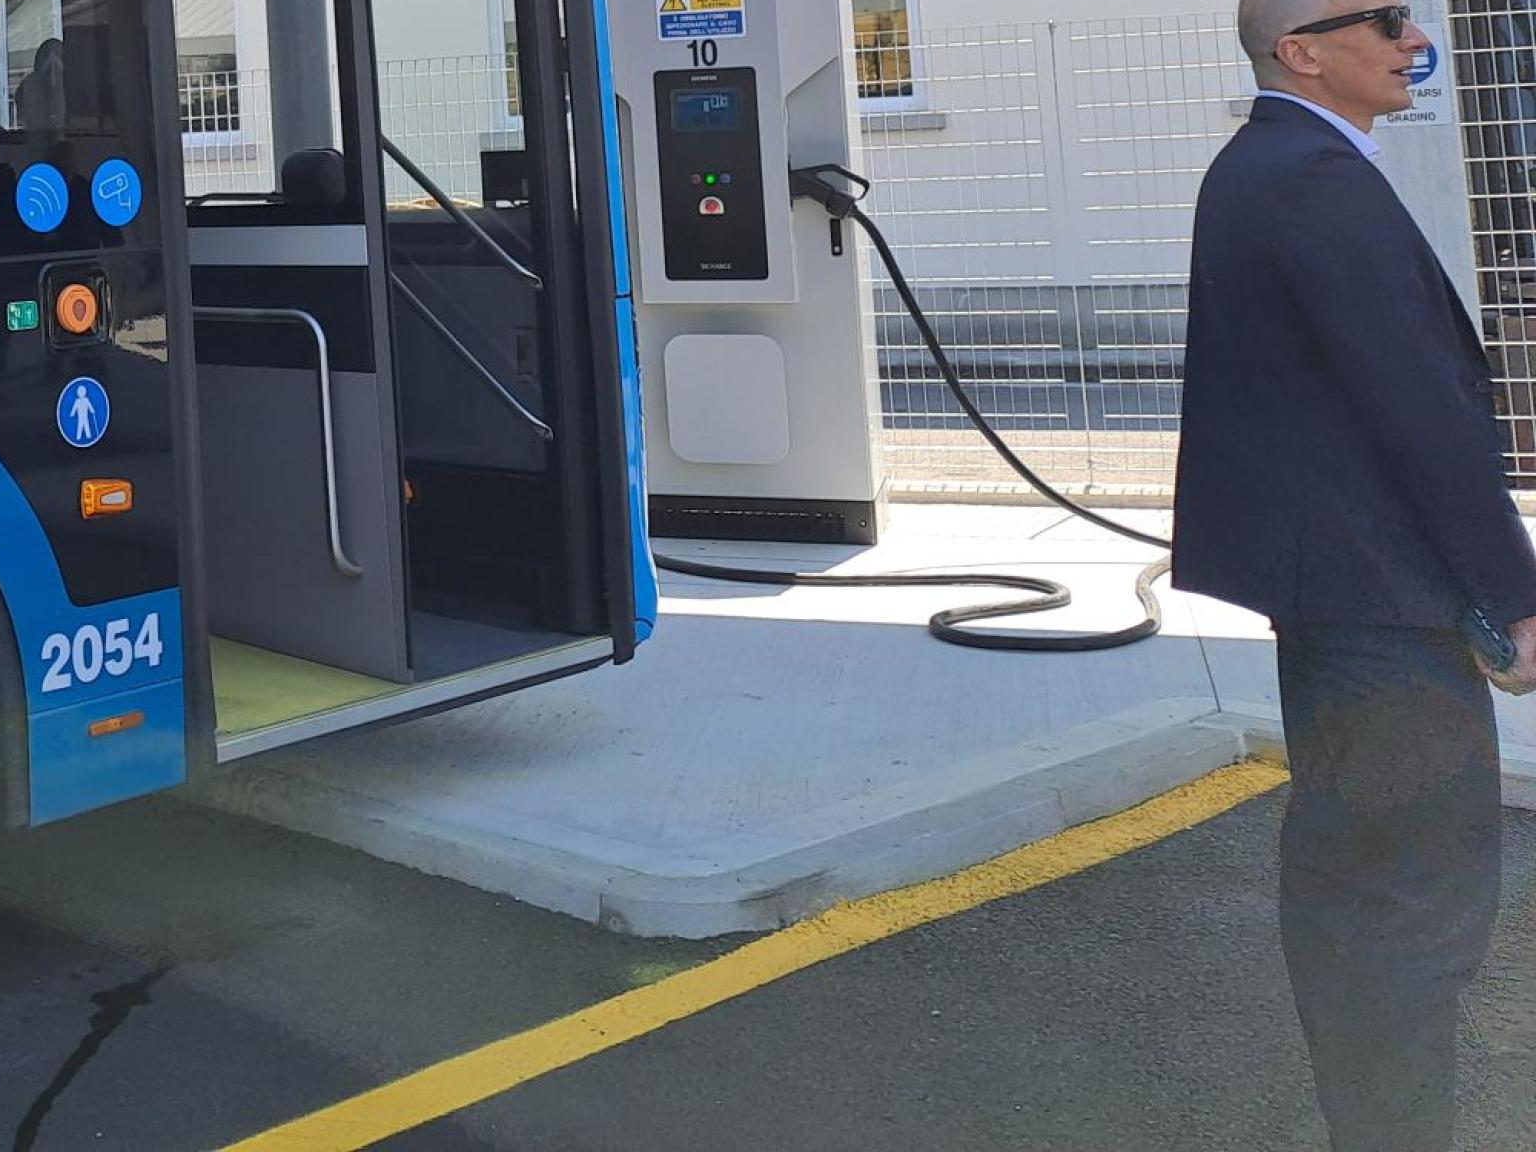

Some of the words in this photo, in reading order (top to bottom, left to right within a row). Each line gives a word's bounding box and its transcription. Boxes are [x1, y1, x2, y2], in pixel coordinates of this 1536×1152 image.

[687, 39, 718, 67] 10
[1407, 88, 1442, 98] TARSI
[1386, 112, 1437, 122] GRADINO
[41, 612, 164, 693] 2054
